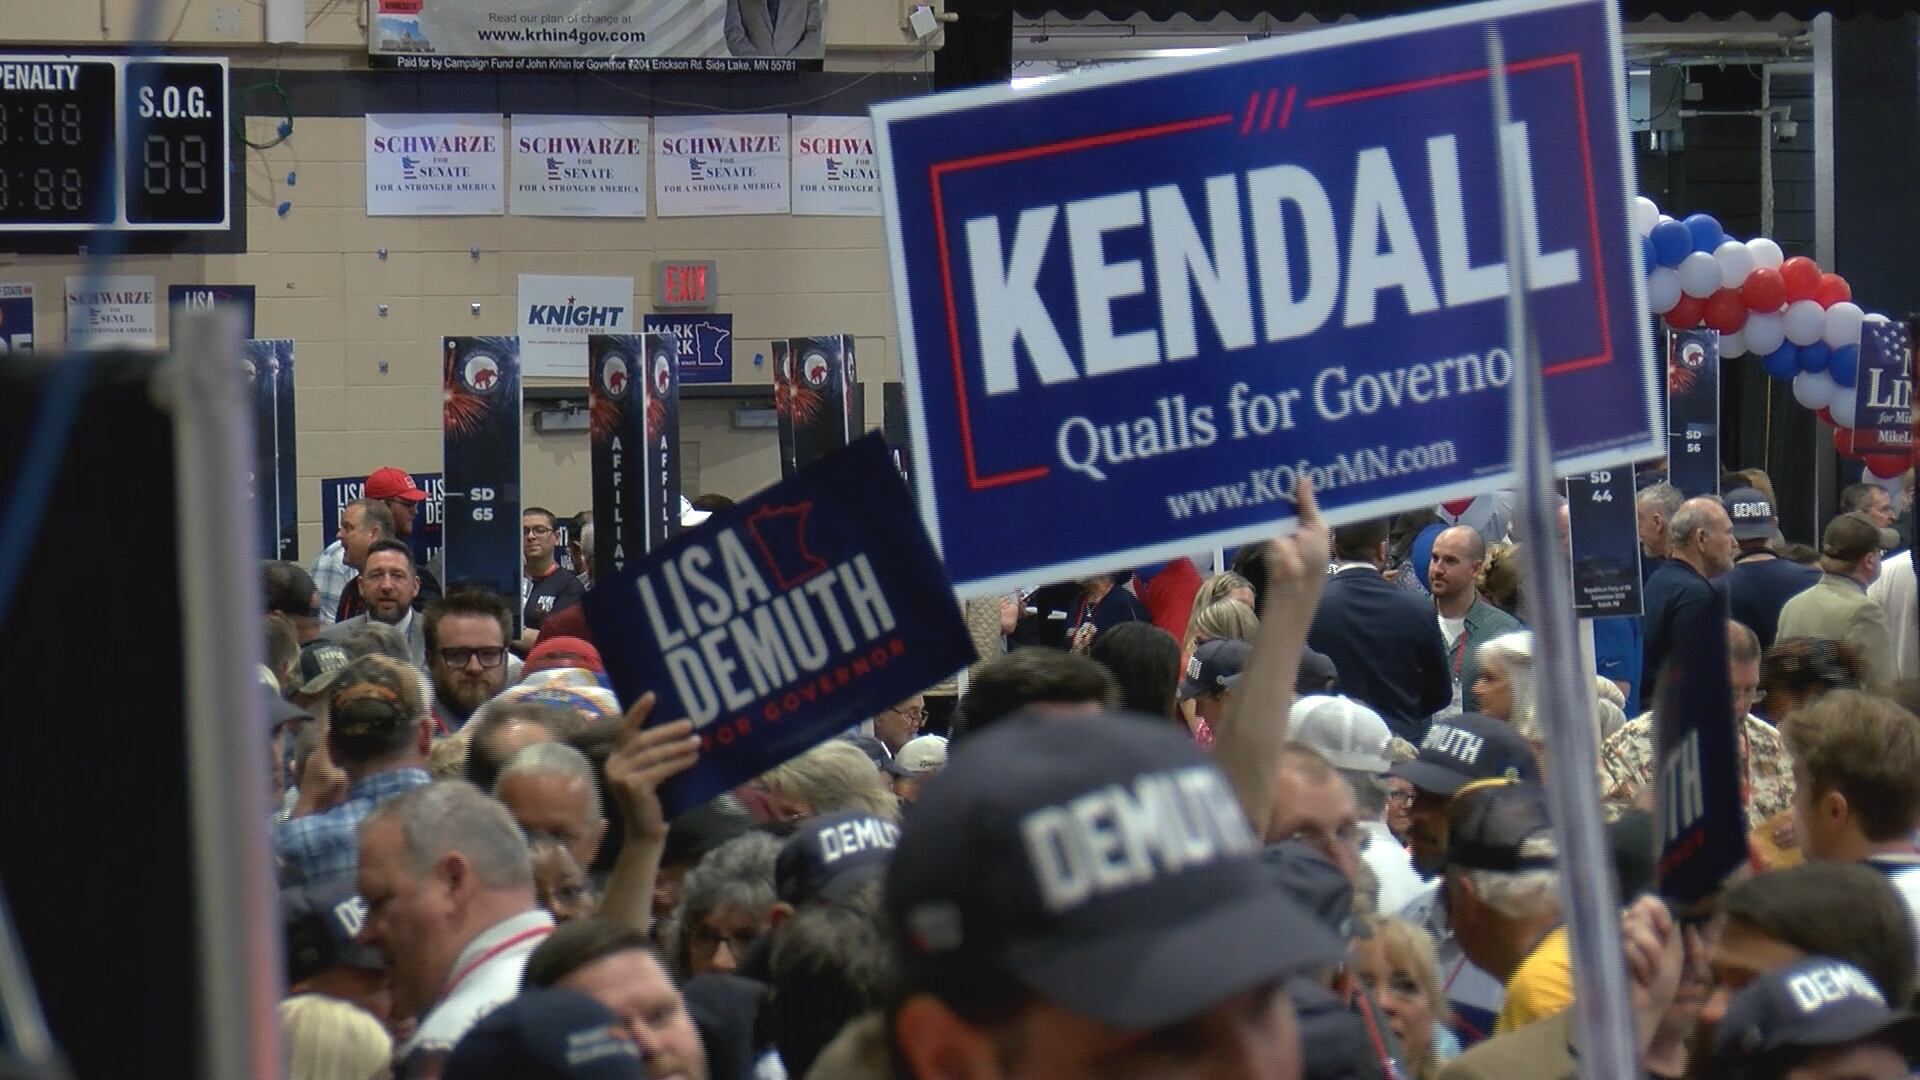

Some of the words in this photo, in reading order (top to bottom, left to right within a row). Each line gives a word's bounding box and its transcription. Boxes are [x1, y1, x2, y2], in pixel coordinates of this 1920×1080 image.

[489, 13, 517, 23] Read
[520, 15, 537, 23] our
[540, 13, 563, 26] plan
[567, 13, 578, 23] of
[581, 13, 619, 26] change
[621, 14, 632, 24] at
[478, 28, 646, 44] www.krhin4gov.com
[397, 57, 416, 68] Paid
[419, 57, 430, 68] for
[432, 58, 443, 71] by
[444, 58, 490, 71] Campaign
[491, 58, 514, 69] Fund
[515, 58, 525, 69] of
[526, 58, 547, 70] John
[549, 58, 572, 70] Krhin
[573, 58, 585, 70] for
[652, 59, 689, 71] Erickson
[706, 59, 726, 71] Side
[754, 60, 770, 71] MN
[771, 60, 796, 71] 55781
[0, 64, 79, 90] ENALTY
[139, 86, 212, 118] S.O.G.
[374, 135, 496, 153] SCHWARZE
[519, 136, 640, 155] SCHWARZE
[662, 135, 781, 155] SCHWARZE
[420, 166, 471, 178] SENATE
[563, 168, 614, 179] SENATE
[706, 166, 757, 178] SENATE
[375, 183, 394, 192] FOR
[404, 183, 453, 192] STRONGER
[457, 183, 497, 191] AMERICA
[519, 184, 537, 192] FOR
[549, 184, 596, 192] STRONGER
[600, 184, 639, 193] AMERICA
[664, 185, 682, 193] FOR
[691, 183, 739, 192] STRONGER
[742, 182, 782, 191] AMERICA
[800, 184, 817, 192] FOR
[828, 184, 874, 193] STRONGER
[965, 119, 1581, 396] KENDALL
[3, 285, 23, 296] STATE
[665, 265, 708, 303] EXIT
[68, 292, 153, 305] SCHWARZE
[101, 315, 136, 323] SENATE
[528, 304, 624, 327] KNIGHT
[1057, 394, 1219, 481] Qualls
[1228, 382, 1301, 440] for
[1313, 347, 1515, 421] Governo
[1686, 430, 1702, 440] SD
[1687, 443, 1701, 453] 56
[1590, 471, 1612, 484] SD
[337, 482, 365, 507] LISA
[470, 488, 495, 501] SD
[1592, 489, 1613, 502] 44
[472, 507, 494, 521] 65
[636, 527, 771, 653] LISA
[663, 551, 896, 729] DEMUTH
[763, 637, 906, 723] GOVERNOR
